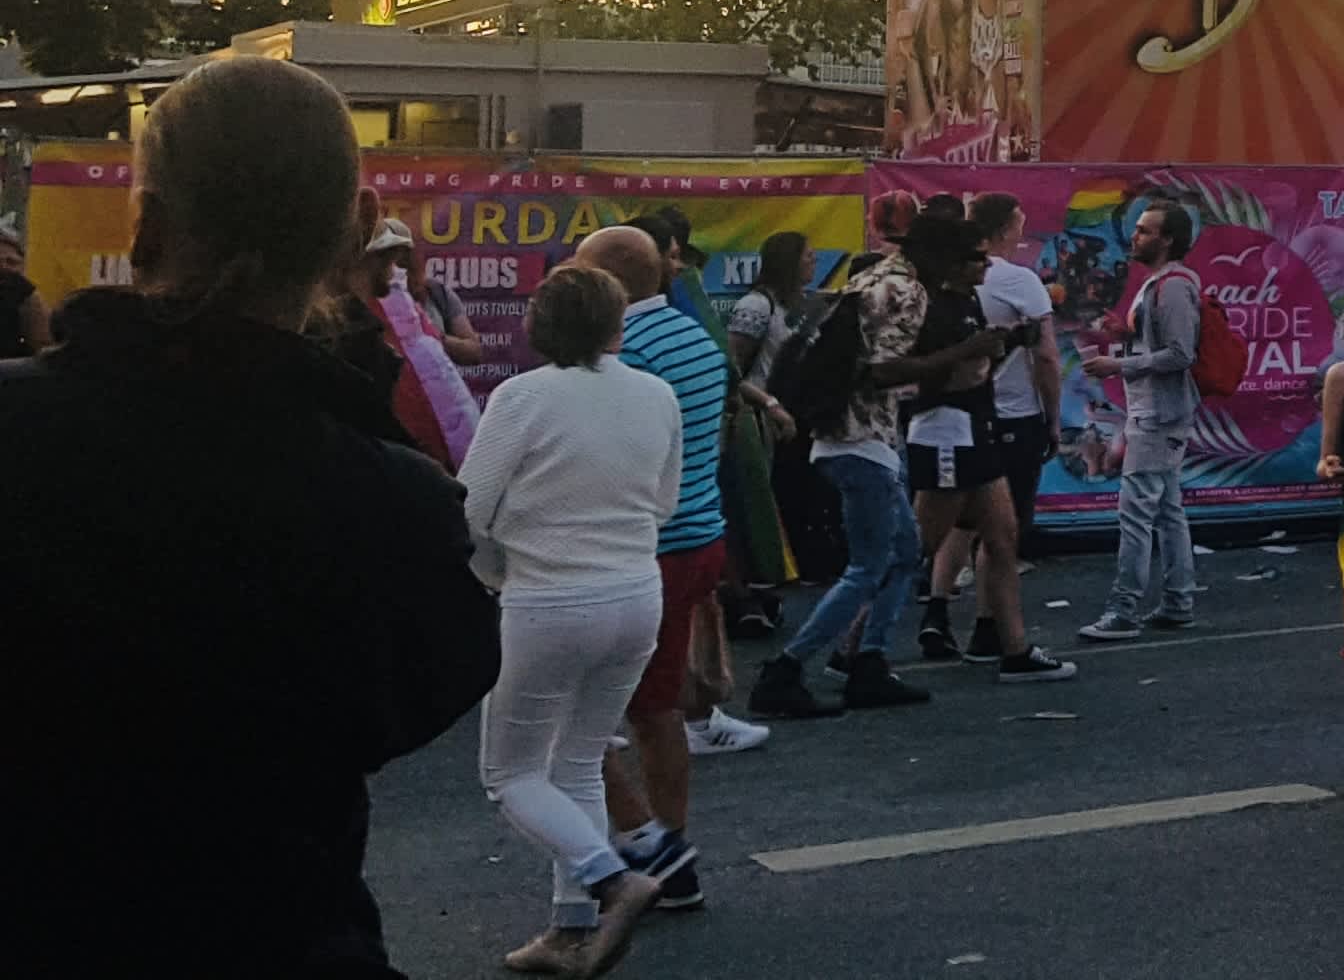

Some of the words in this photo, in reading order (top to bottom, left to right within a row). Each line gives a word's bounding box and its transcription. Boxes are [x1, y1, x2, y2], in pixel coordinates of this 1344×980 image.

[489, 175, 585, 188] PRIDE
[614, 178, 692, 189] MAIN
[719, 177, 813, 190] EVENT
[425, 256, 519, 289] CLUBS
[1204, 267, 1284, 305] each
[1225, 306, 1313, 339] RIDE
